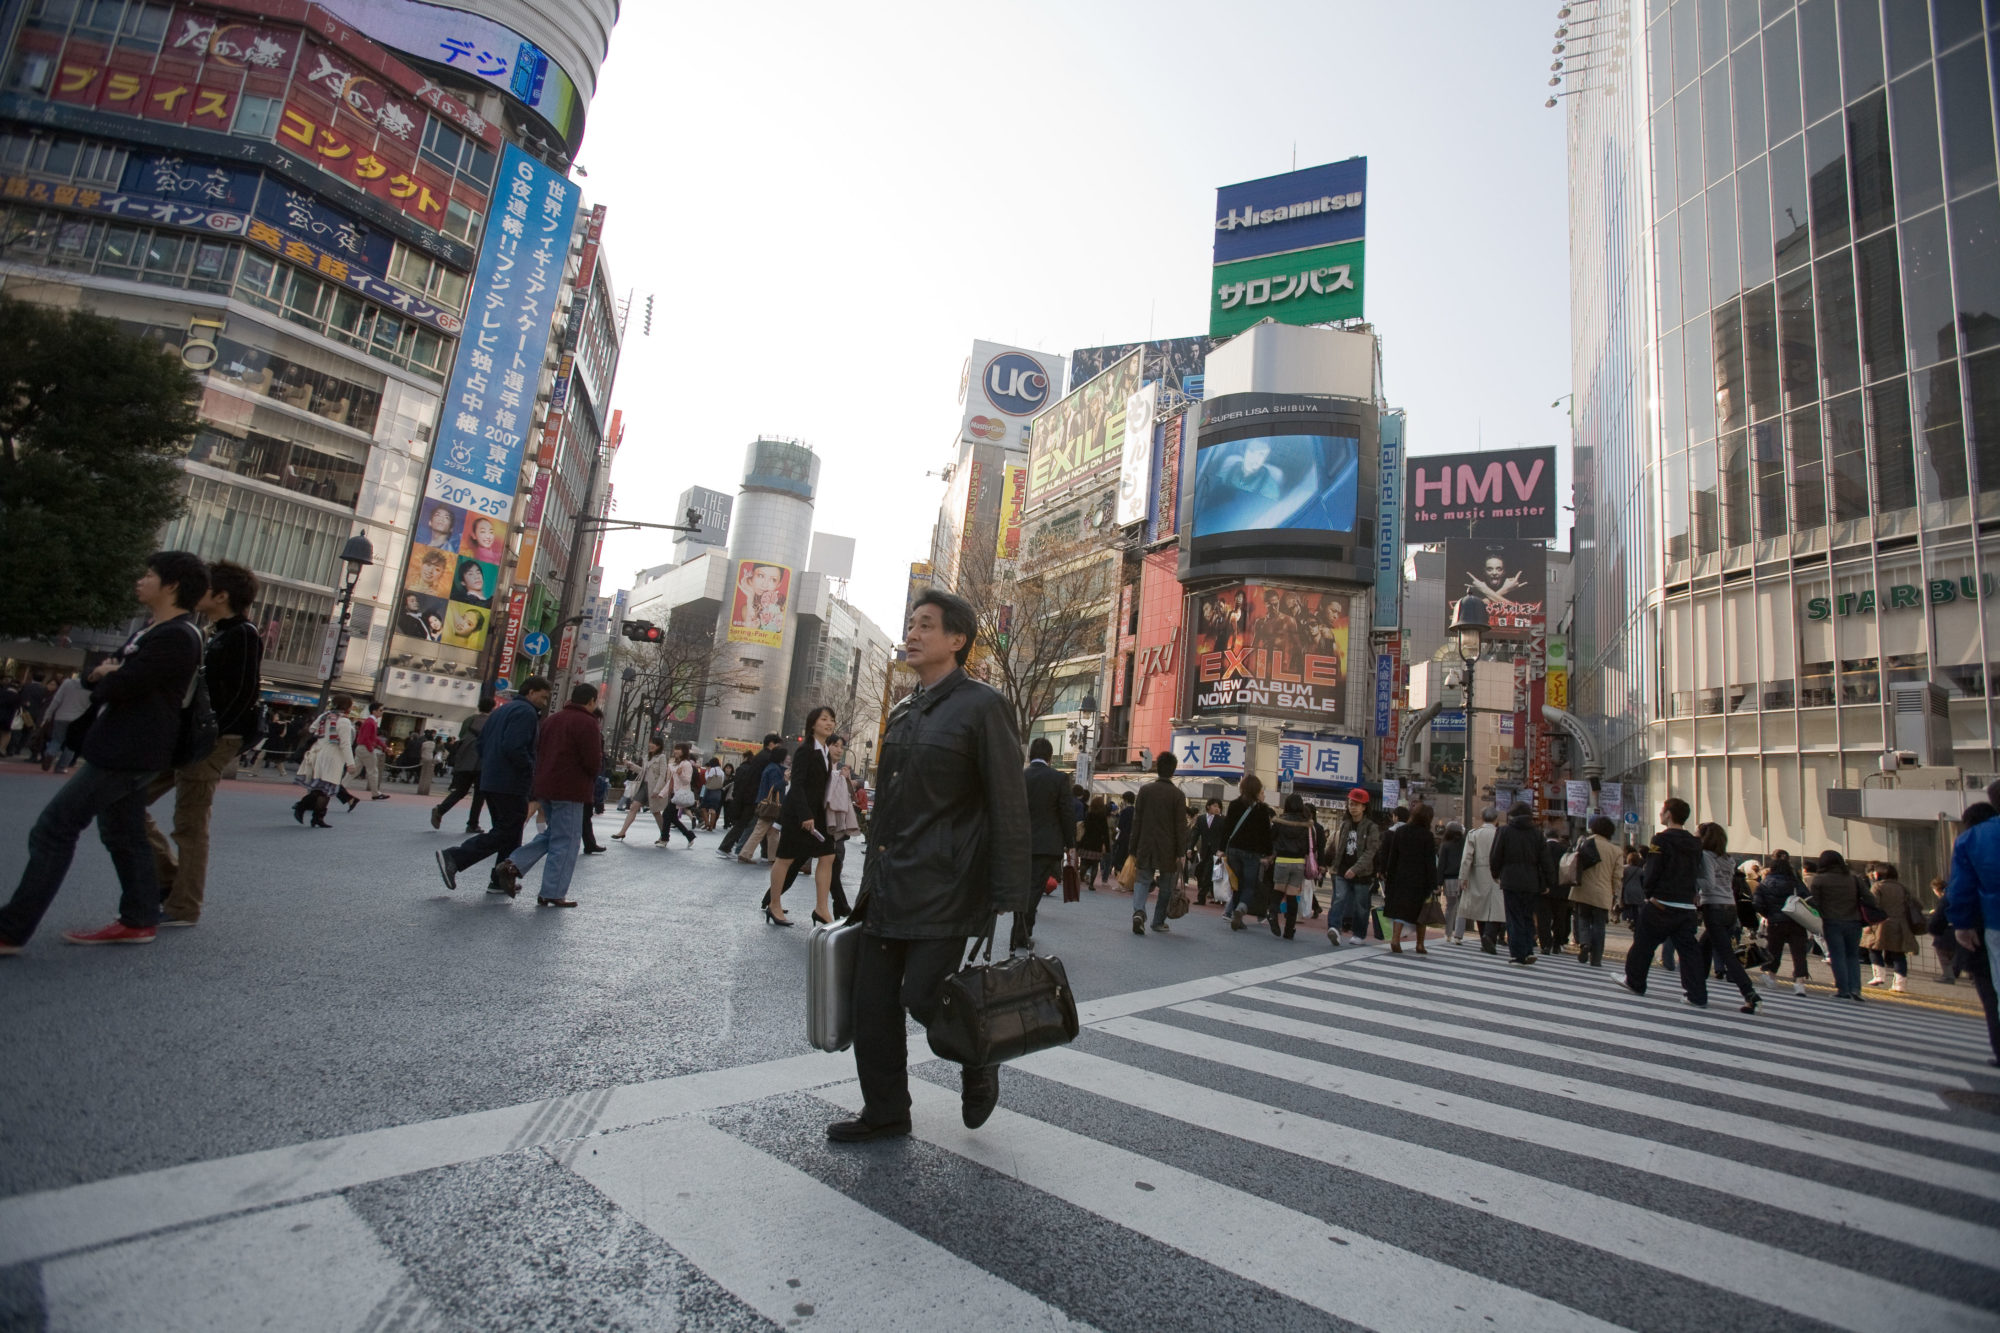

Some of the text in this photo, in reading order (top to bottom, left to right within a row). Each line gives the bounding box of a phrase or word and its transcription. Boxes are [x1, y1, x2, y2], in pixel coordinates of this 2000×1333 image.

[275, 154, 293, 169] 7F
[281, 109, 441, 214] コンタクト
[103, 197, 205, 225] イーオン
[211, 215, 238, 230] 6F
[1215, 191, 1362, 230] Hisamitsu
[248, 219, 458, 330] 英会話 イーオン 6F
[1218, 264, 1354, 310] サロンパス
[1211, 404, 1318, 424] SUPER LISA SHIBUYA
[1030, 410, 1126, 491] EXILE
[1105, 446, 1123, 462] SAL
[704, 491, 725, 512] THE
[1415, 458, 1545, 508] HMV
[1380, 437, 1397, 571] Taisei neon
[1415, 506, 1545, 522] the music master
[1807, 572, 2000, 621] STARBU
[1200, 648, 1336, 686] EXILE
[1530, 621, 1545, 681] さくらや
[1198, 691, 1233, 706] NOW
[1236, 690, 1269, 705] ON
[1277, 694, 1336, 712] SALE
[1213, 679, 1312, 696] NEW ALBUM
[1377, 659, 1391, 732] 大盛堂商事ビル
[1513, 664, 1526, 714] さくらや
[1183, 740, 1341, 773] 大盛書店
